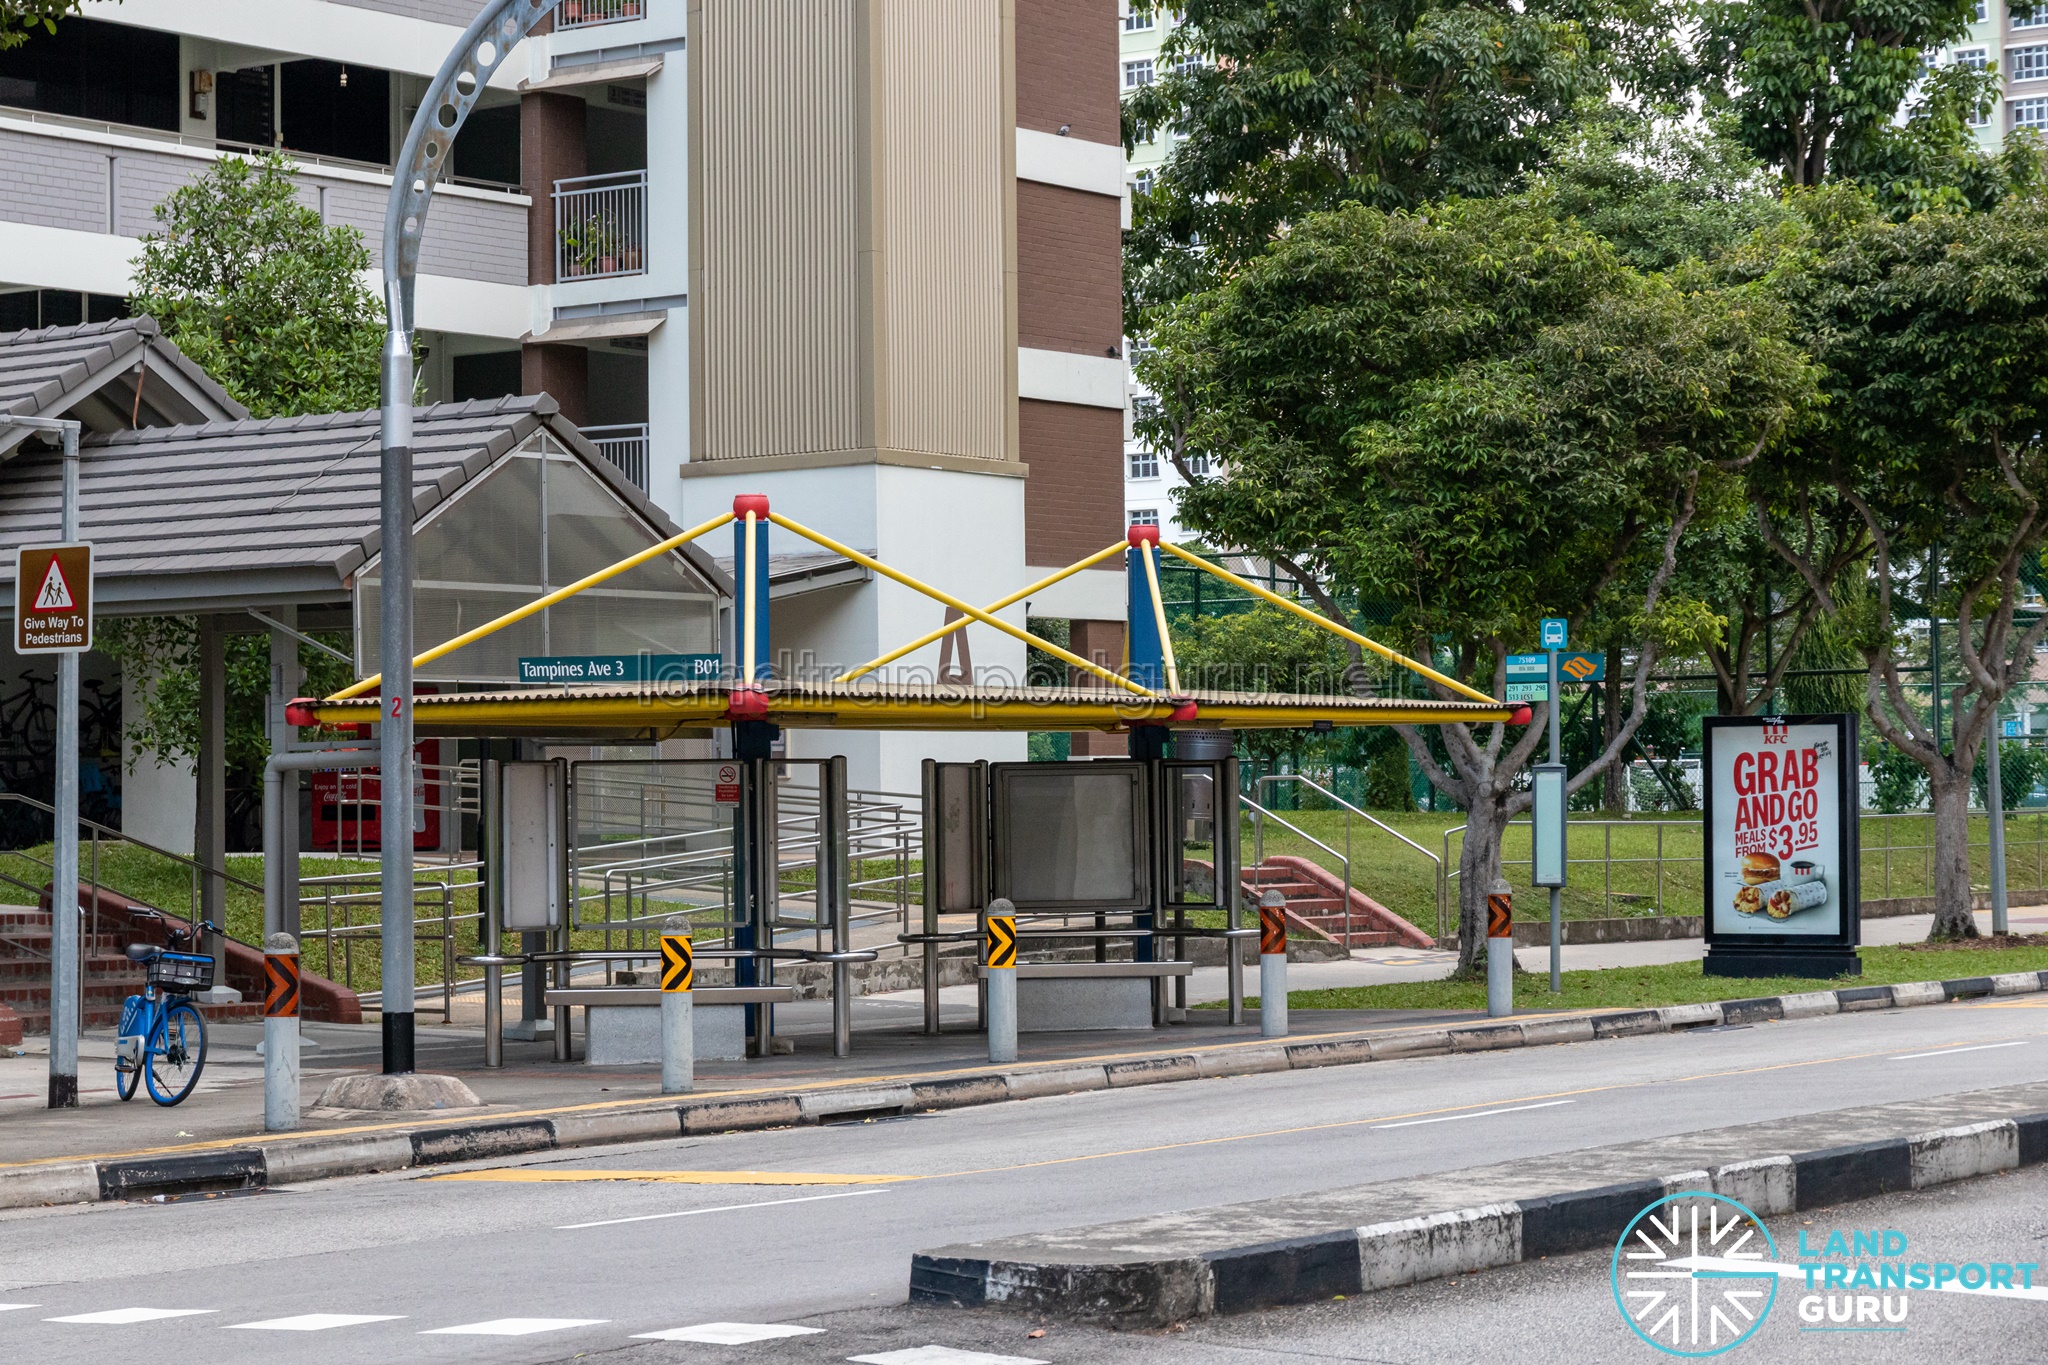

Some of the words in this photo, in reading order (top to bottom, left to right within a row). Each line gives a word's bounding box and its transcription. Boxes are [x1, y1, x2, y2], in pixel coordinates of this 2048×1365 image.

[24, 617, 46, 629] Give
[48, 616, 69, 630] Way
[71, 615, 84, 627] To
[25, 632, 82, 645] Pedestrians
[521, 660, 583, 680] Tampines
[587, 661, 612, 676] Ave
[615, 660, 625, 676] 3
[694, 658, 720, 674] B01
[391, 696, 402, 718] 2
[1763, 734, 1788, 744] KFC
[1733, 748, 1819, 796] GRAB
[314, 783, 329, 791] Enjoy
[1734, 793, 1785, 832] AND
[1788, 788, 1818, 823] GO
[1735, 828, 1766, 846] MEALS
[1768, 821, 1818, 860] $3.95
[1735, 841, 1766, 858] FROM
